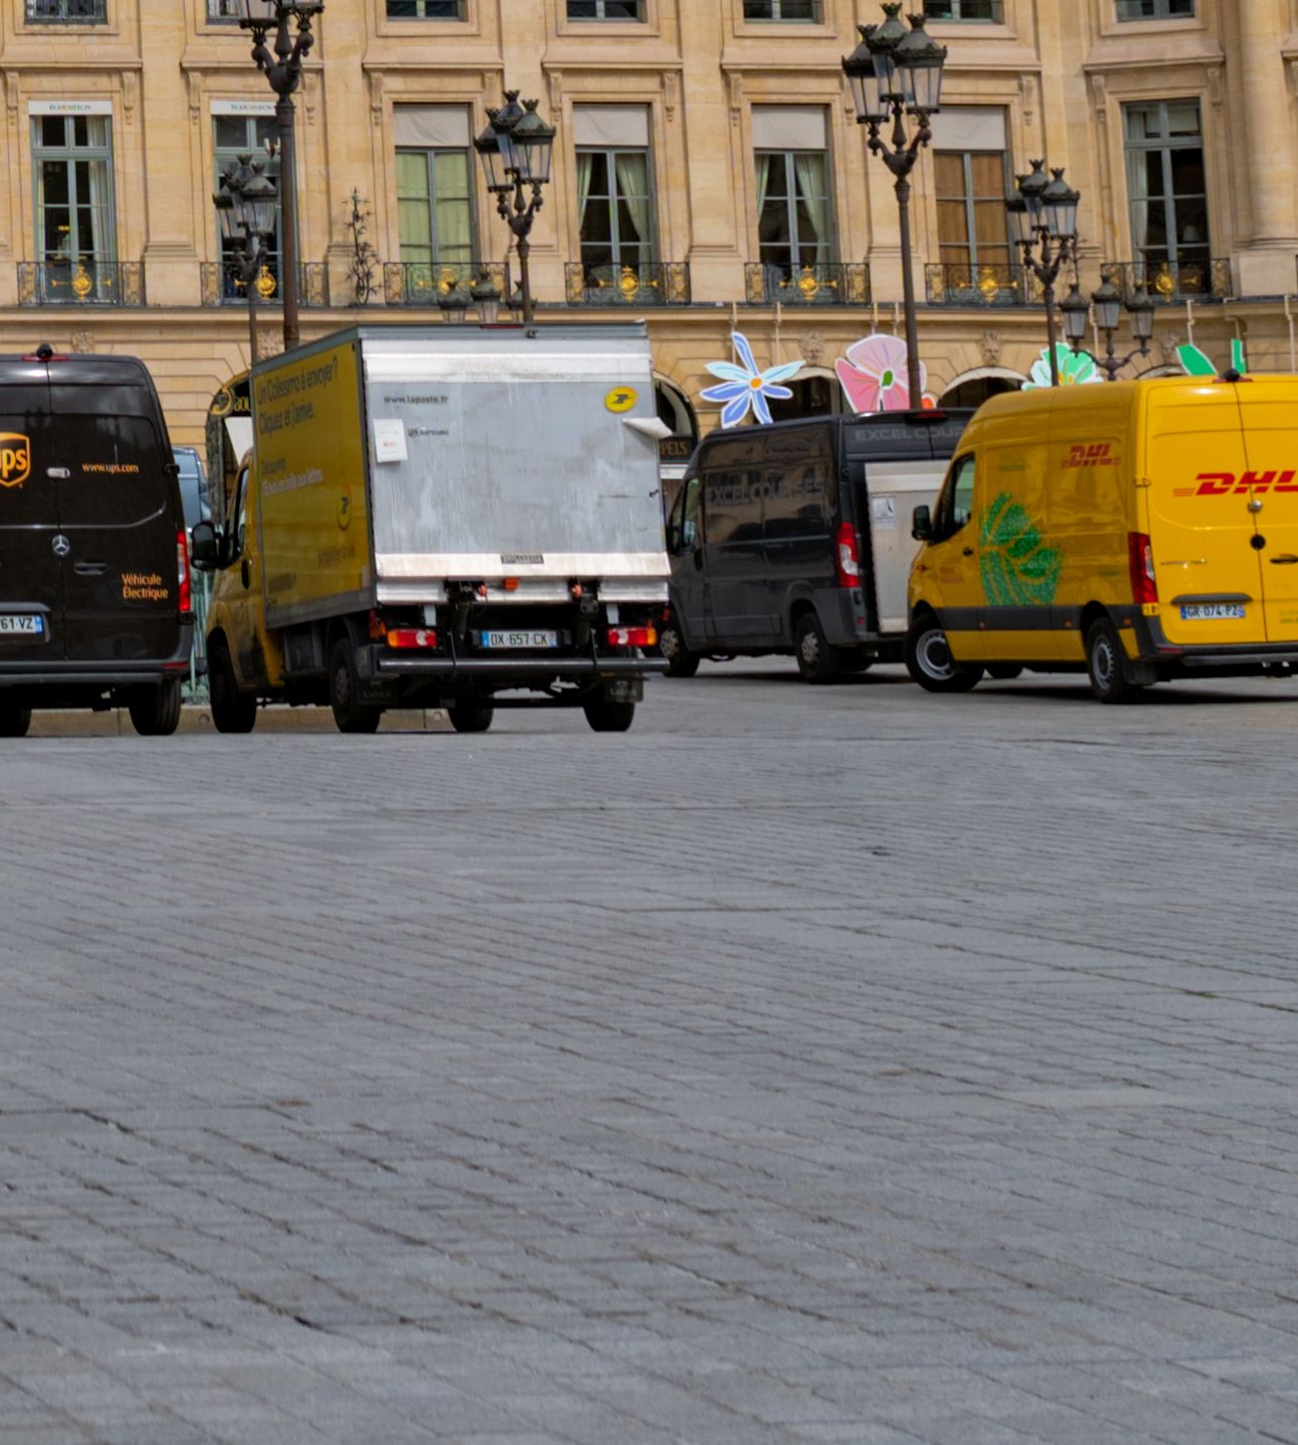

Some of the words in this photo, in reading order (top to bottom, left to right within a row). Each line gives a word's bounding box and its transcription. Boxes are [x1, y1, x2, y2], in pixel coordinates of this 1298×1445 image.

[660, 441, 688, 456] PELS
[1068, 443, 1112, 468] DHL
[82, 463, 139, 476] www.ups.com
[1195, 470, 1298, 496] DHL
[122, 572, 162, 585] Véhicule
[122, 585, 168, 601] Électrique
